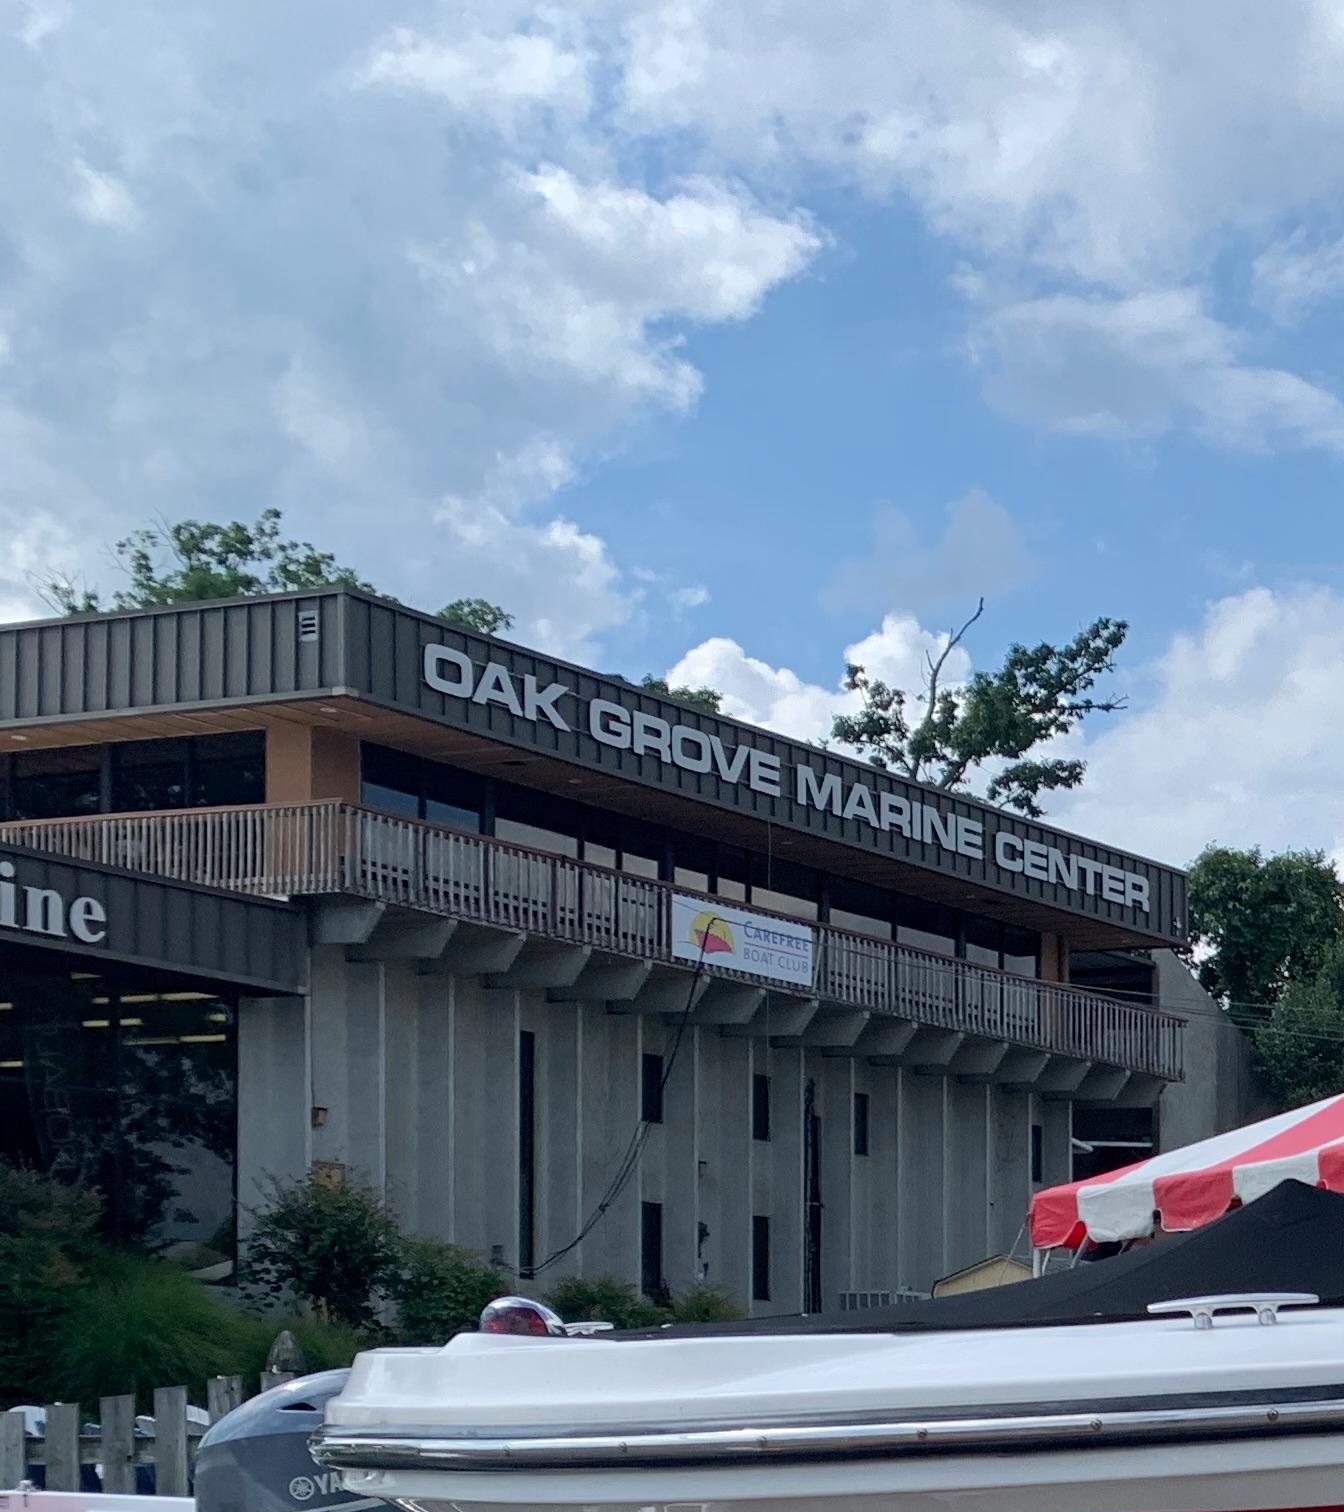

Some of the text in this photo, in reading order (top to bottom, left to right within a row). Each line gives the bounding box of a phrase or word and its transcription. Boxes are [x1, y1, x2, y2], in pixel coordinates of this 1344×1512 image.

[423, 643, 1150, 912] OAK GROVE MARINE CENTER
[744, 920, 809, 952] CAREFREE
[744, 949, 809, 974] BOAT CLUB
